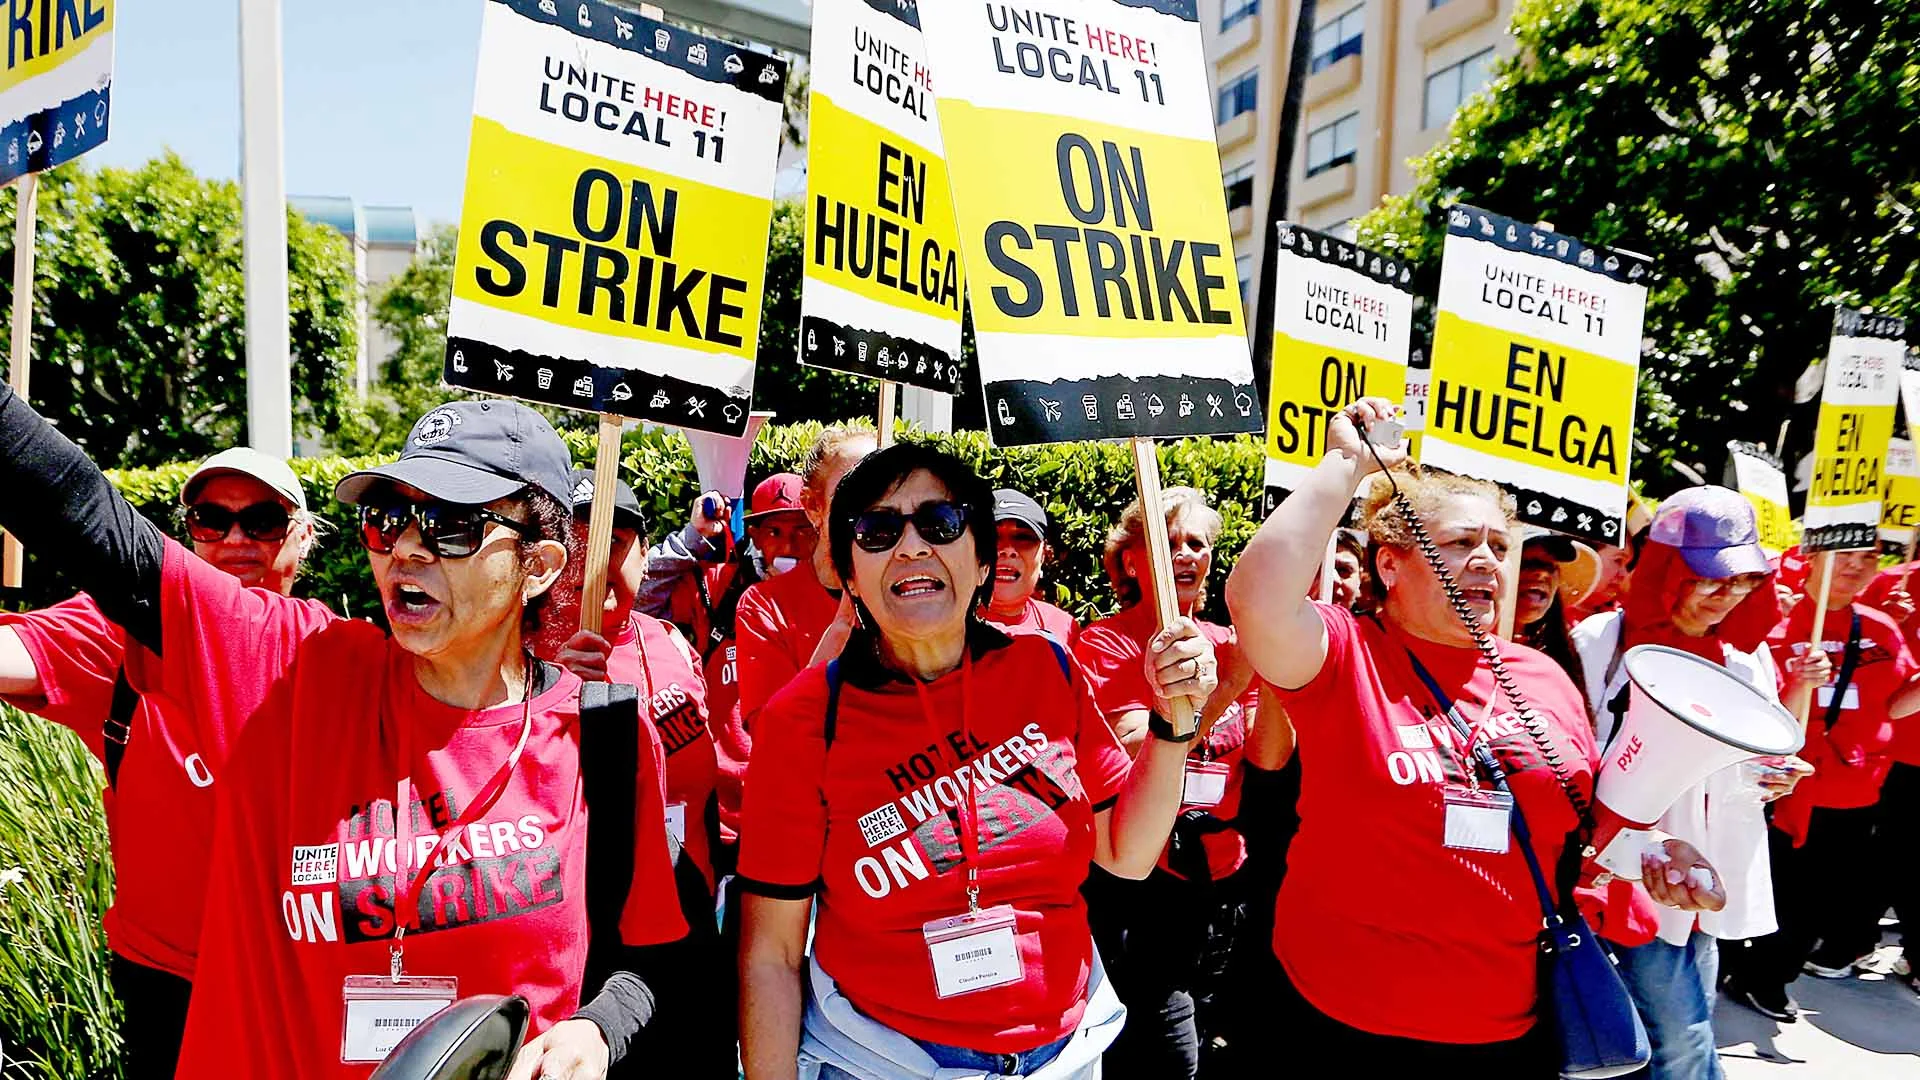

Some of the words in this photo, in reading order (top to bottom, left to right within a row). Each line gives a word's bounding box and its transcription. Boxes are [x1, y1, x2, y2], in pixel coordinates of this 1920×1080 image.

[854, 26, 909, 77] UNITE
[986, 3, 1079, 46] UNITE
[1085, 24, 1158, 67] HERE!
[544, 56, 635, 104] UNITE
[644, 87, 727, 131] HERE!
[853, 54, 927, 122] LOCAL
[992, 36, 1120, 95] LOCAL
[1134, 69, 1165, 106] 11
[540, 83, 671, 147] LOCAL
[693, 130, 724, 164] 11
[877, 141, 926, 225] EN
[1056, 132, 1153, 232] ON
[572, 168, 678, 258] ON
[814, 195, 959, 312] HUELGA
[984, 220, 1233, 325] STRIKE
[475, 219, 747, 348] STRIKE
[1307, 279, 1349, 307] UNITE
[1353, 294, 1389, 318] HERE!
[1482, 283, 1568, 325] LOCAL
[1584, 313, 1605, 336] 11
[1485, 263, 1545, 293] UNITE
[1552, 283, 1606, 314] HERE!
[1305, 300, 1364, 335] LOCAL
[1374, 320, 1387, 342] 11
[1320, 356, 1366, 408] ON
[1506, 342, 1567, 403] EN
[1434, 380, 1618, 475] HUELGA
[900, 722, 1049, 822] WORKERS
[1387, 751, 1445, 785] ON
[1617, 735, 1643, 771] PYLE
[860, 805, 896, 828] UNITE
[864, 814, 900, 838] HERE!
[868, 829, 894, 844] LOCAL
[896, 823, 904, 831] 11
[293, 874, 323, 882] LOCAL
[294, 859, 335, 873] HERE!
[295, 847, 337, 861] UNITE
[854, 838, 930, 898] ON
[282, 890, 338, 943] ON
